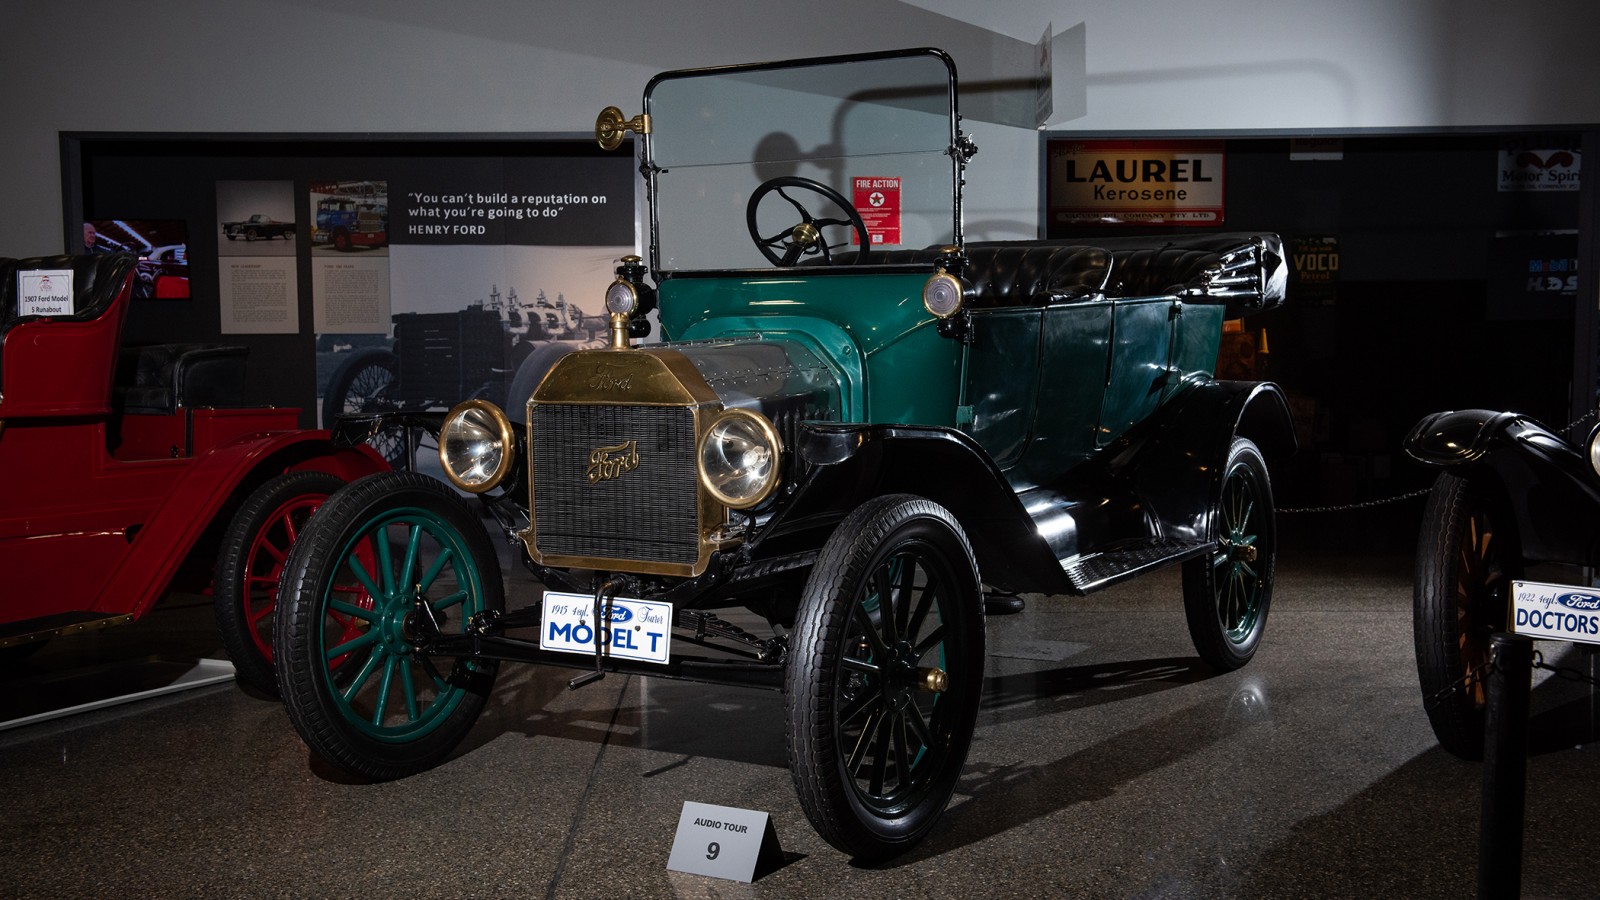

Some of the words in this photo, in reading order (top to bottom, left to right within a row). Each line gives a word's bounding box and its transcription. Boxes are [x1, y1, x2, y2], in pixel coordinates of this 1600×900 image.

[1066, 159, 1213, 183] LAUREL
[1502, 170, 1542, 182] Motor
[856, 179, 871, 188] FIRE
[872, 179, 899, 188] ACTION
[441, 193, 474, 204] can't
[476, 193, 508, 204] build
[511, 195, 518, 204] a
[522, 193, 588, 206] reputation
[591, 195, 607, 204] on
[1094, 185, 1187, 200] Kerosene
[408, 206, 441, 218] what
[443, 207, 484, 220] you're
[487, 207, 523, 220] going
[526, 207, 539, 218] to
[542, 206, 564, 218] do"
[409, 225, 450, 235] HENRY
[453, 225, 486, 235] FORD
[1292, 253, 1339, 271] VOCO
[1528, 258, 1568, 273] Mobil
[1300, 271, 1331, 281] Petrol
[589, 362, 633, 391] Ford
[587, 440, 640, 484] Ford
[1518, 592, 1536, 602] 1922
[1566, 594, 1600, 609] Ford
[551, 604, 568, 616] 1915
[600, 605, 627, 621] Ford
[637, 605, 664, 625] Tourer
[1516, 608, 1599, 635] DOCTORS
[549, 621, 639, 650] MODEL
[646, 631, 663, 653] T
[694, 817, 722, 829] AUDIO
[723, 822, 748, 834] TOUR
[706, 842, 720, 860] 9
